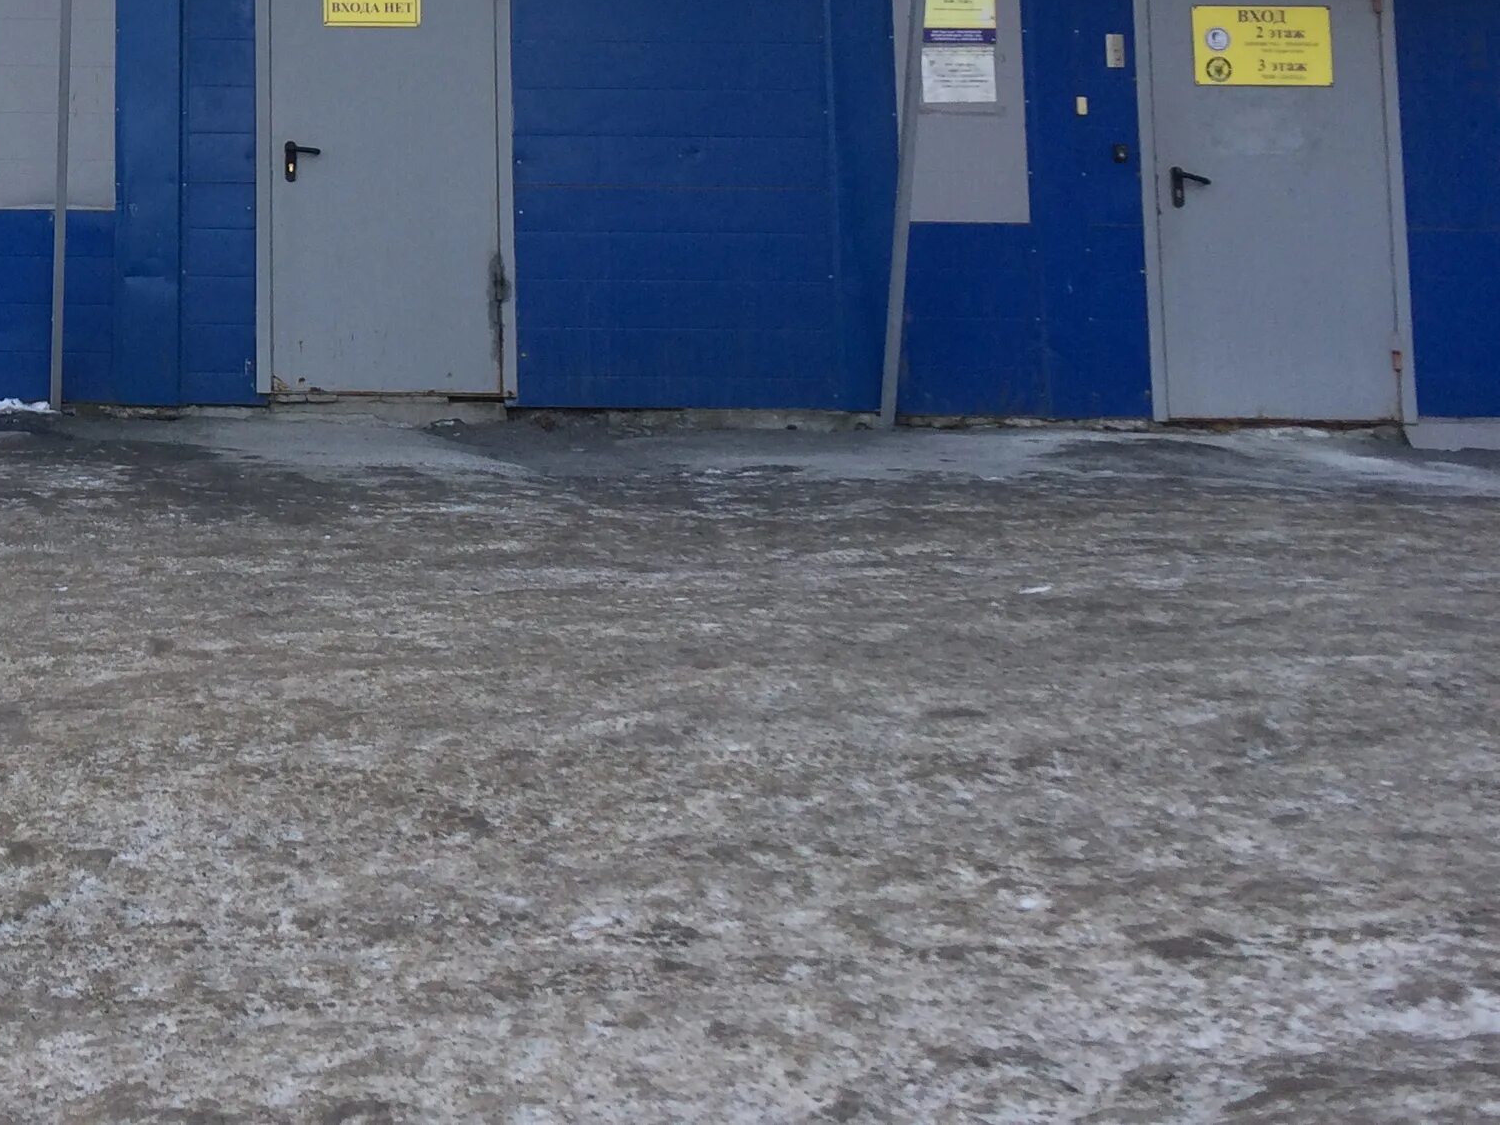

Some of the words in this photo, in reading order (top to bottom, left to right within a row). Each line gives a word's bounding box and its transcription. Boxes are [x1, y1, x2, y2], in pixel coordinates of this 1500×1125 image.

[332, 2, 379, 13] ВХОДА
[384, 2, 413, 13] НЕТ
[1237, 9, 1286, 24] ВХОД
[1255, 26, 1263, 38] 2
[1268, 29, 1305, 39] этаж
[1257, 59, 1266, 72] 3
[1271, 62, 1307, 72] этаж
